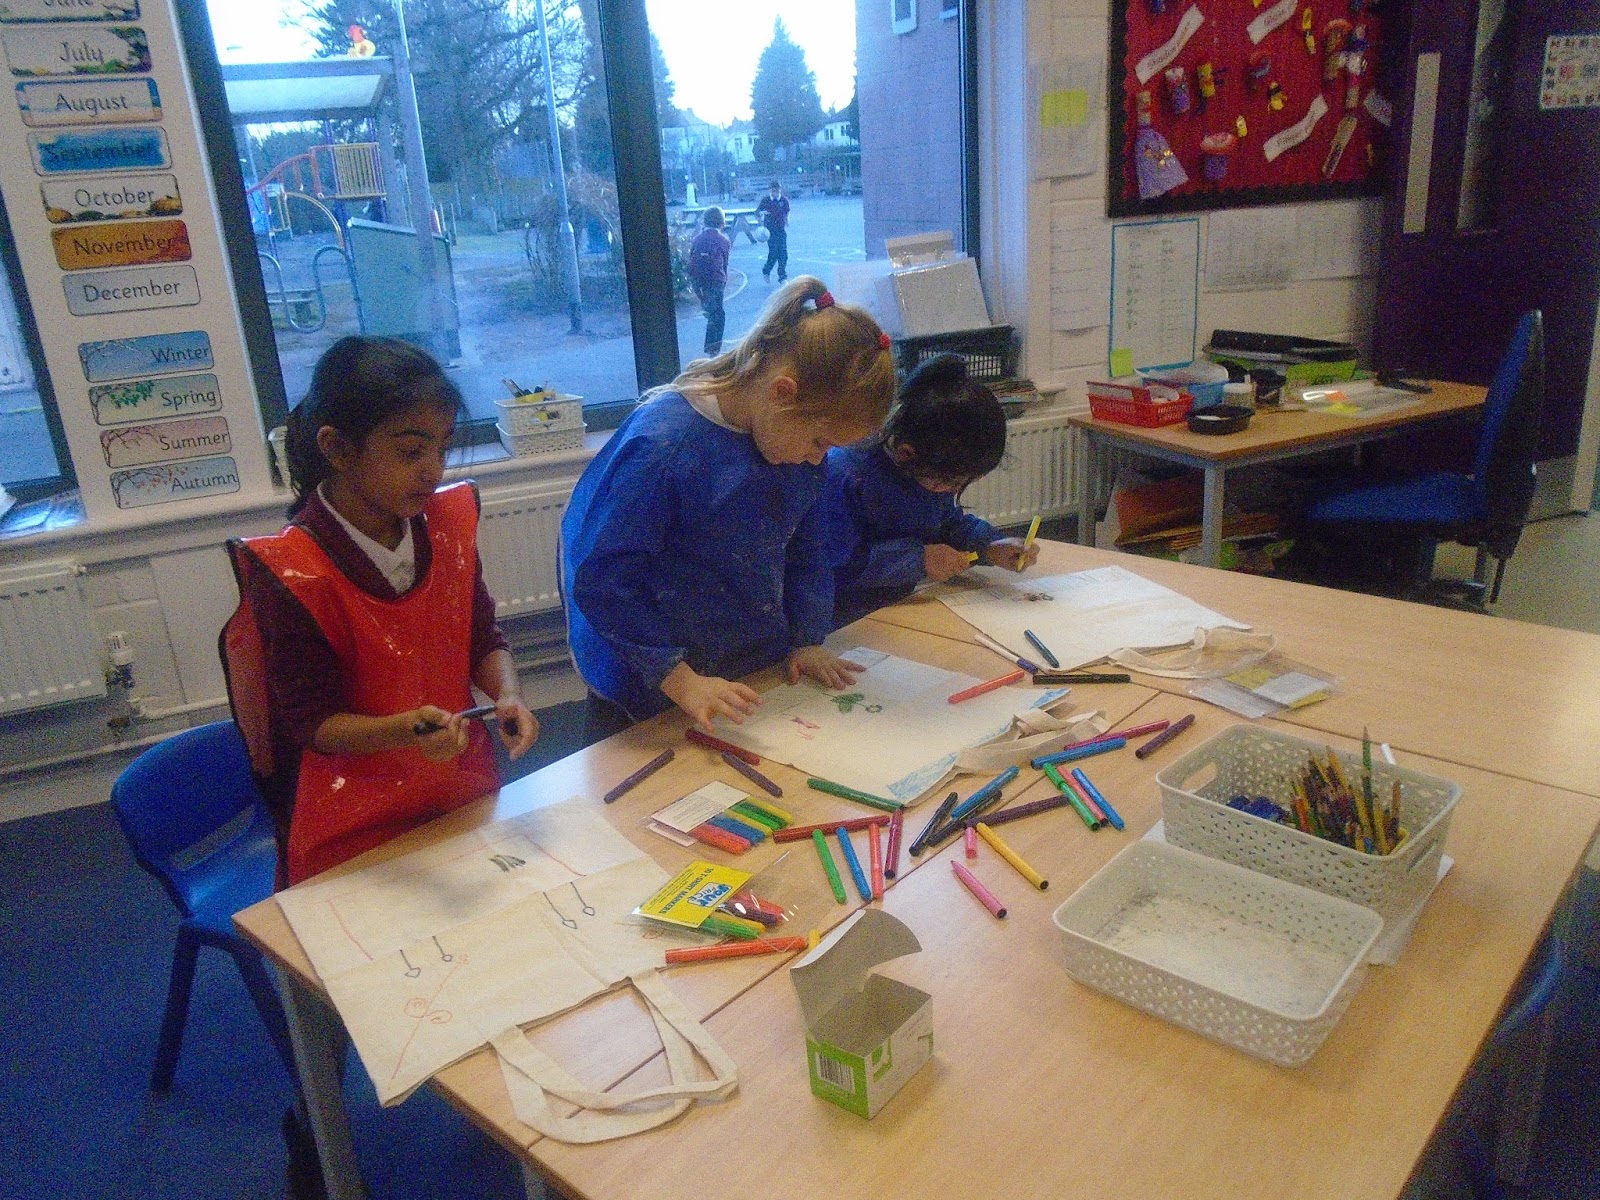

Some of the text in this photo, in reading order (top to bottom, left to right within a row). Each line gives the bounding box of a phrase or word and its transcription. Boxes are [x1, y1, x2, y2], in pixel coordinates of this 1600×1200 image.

[60, 41, 104, 64] July
[55, 93, 128, 118] August
[75, 186, 154, 208] October
[73, 233, 174, 256] November
[84, 278, 181, 302] December
[151, 346, 209, 363] Winter
[161, 390, 216, 411] Spring
[159, 431, 228, 451] Summer
[171, 473, 238, 492] Autumn
[685, 872, 709, 891] T-SHIRT
[659, 889, 688, 914] MARKERS
[688, 887, 715, 901] PRICE
